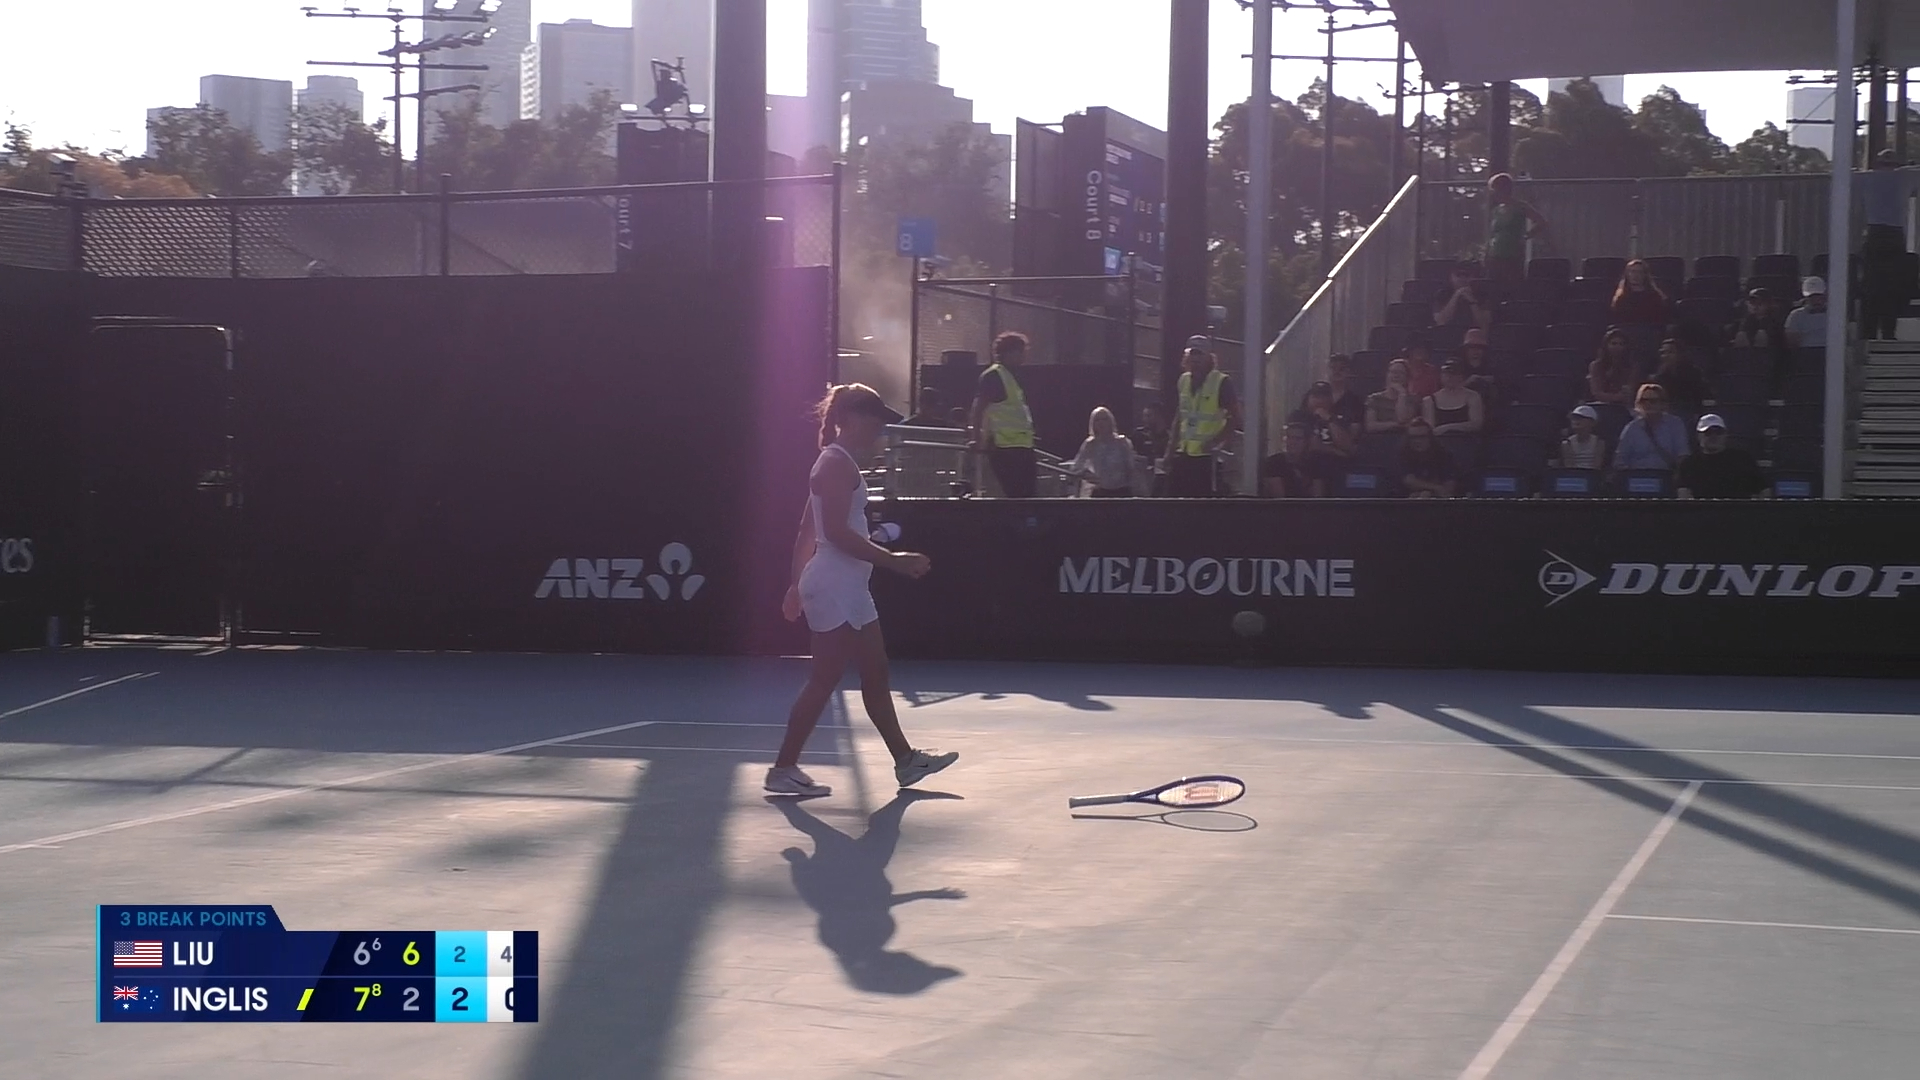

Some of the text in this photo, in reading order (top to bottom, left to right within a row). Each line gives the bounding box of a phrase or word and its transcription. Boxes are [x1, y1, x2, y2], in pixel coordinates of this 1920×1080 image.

[618, 194, 633, 234] ourt
[1085, 170, 1103, 241] Court 8
[899, 233, 914, 251] 8
[0, 537, 33, 573] es
[535, 558, 643, 599] ANZ
[1059, 556, 1356, 597] MELBOURNE
[1598, 563, 1920, 598] DUNLOP
